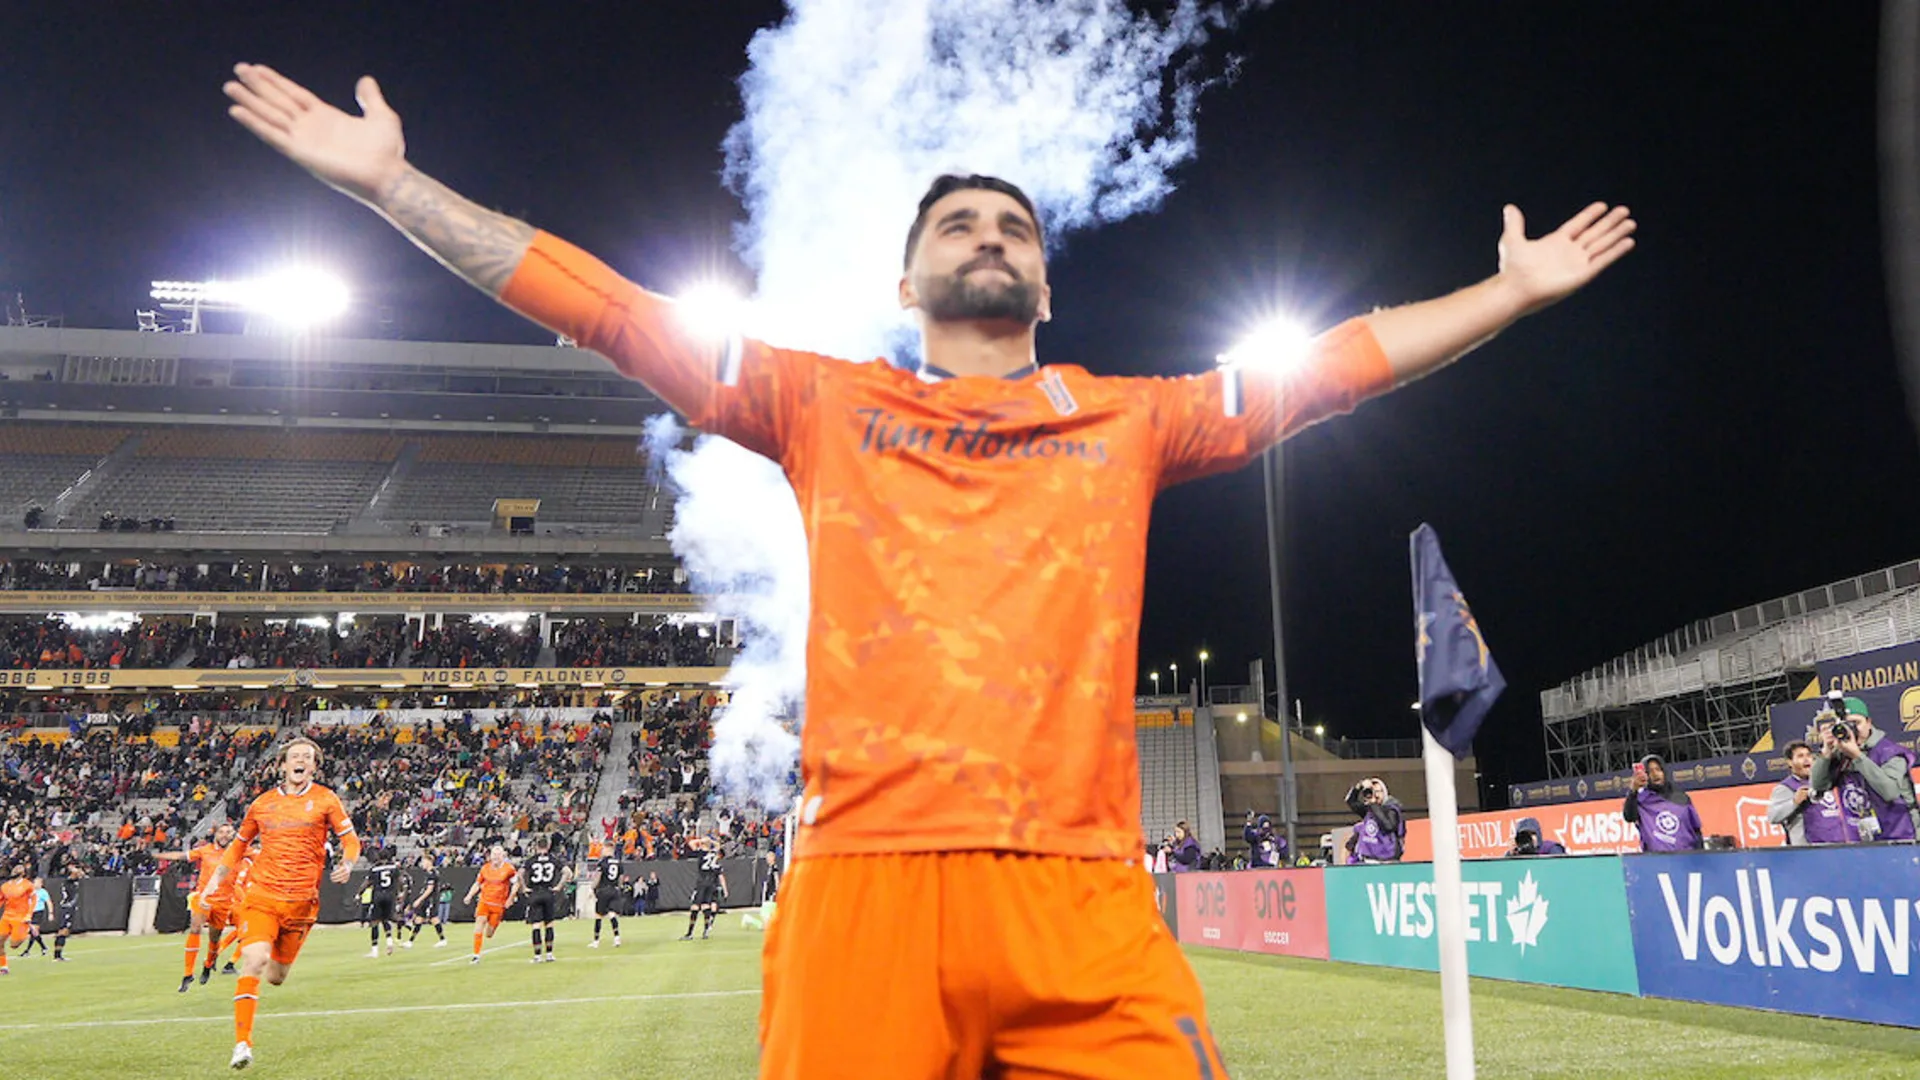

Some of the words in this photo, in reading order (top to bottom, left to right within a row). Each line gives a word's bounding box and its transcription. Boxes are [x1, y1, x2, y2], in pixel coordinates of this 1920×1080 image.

[856, 408, 935, 453] Tim
[943, 420, 1108, 464] Hortons
[62, 672, 111, 685] 1999
[422, 670, 487, 683] MOSCA
[523, 670, 606, 683] FALONEY
[1830, 660, 1919, 693] CANADIAN
[1457, 818, 1516, 850] FINDLA
[1571, 812, 1641, 844] CARSTA
[1747, 815, 1786, 840] STE
[380, 871, 392, 887] 5
[530, 862, 555, 883] 33
[608, 863, 619, 880] 9
[1196, 879, 1226, 917] one
[1254, 878, 1297, 920] one
[1366, 881, 1502, 943] WESET
[1657, 867, 1920, 976] Volksw
